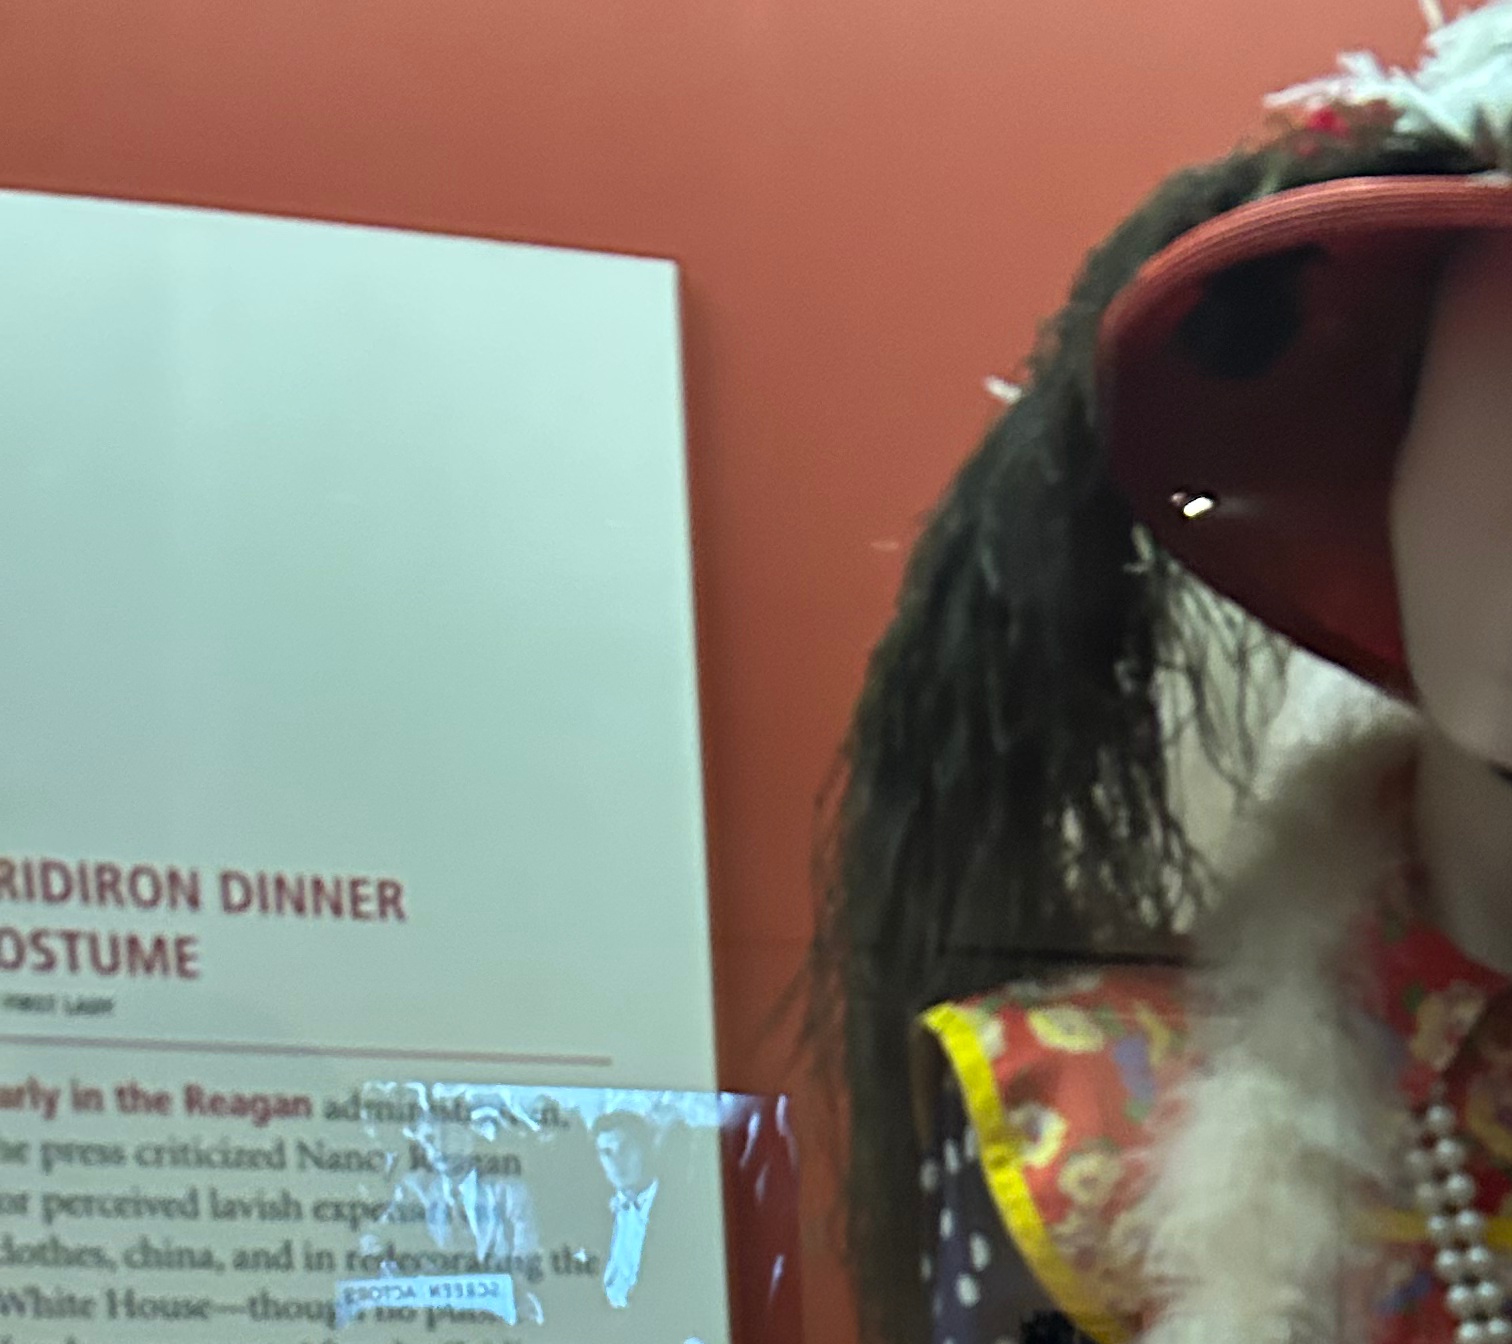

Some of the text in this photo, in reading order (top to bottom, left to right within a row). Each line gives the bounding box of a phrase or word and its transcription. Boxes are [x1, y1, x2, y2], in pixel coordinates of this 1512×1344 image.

[219, 869, 406, 922] DINNER
[0, 926, 200, 980] OSTUME
[70, 1077, 104, 1113] in
[114, 1077, 171, 1116] the
[183, 1082, 313, 1128] Reagan
[41, 1134, 397, 1182] press criticized Nancy
[42, 1185, 199, 1227] perceived
[209, 1185, 304, 1222] lavish
[123, 1234, 226, 1275] china,
[232, 1238, 295, 1272] and
[303, 1238, 335, 1272] in
